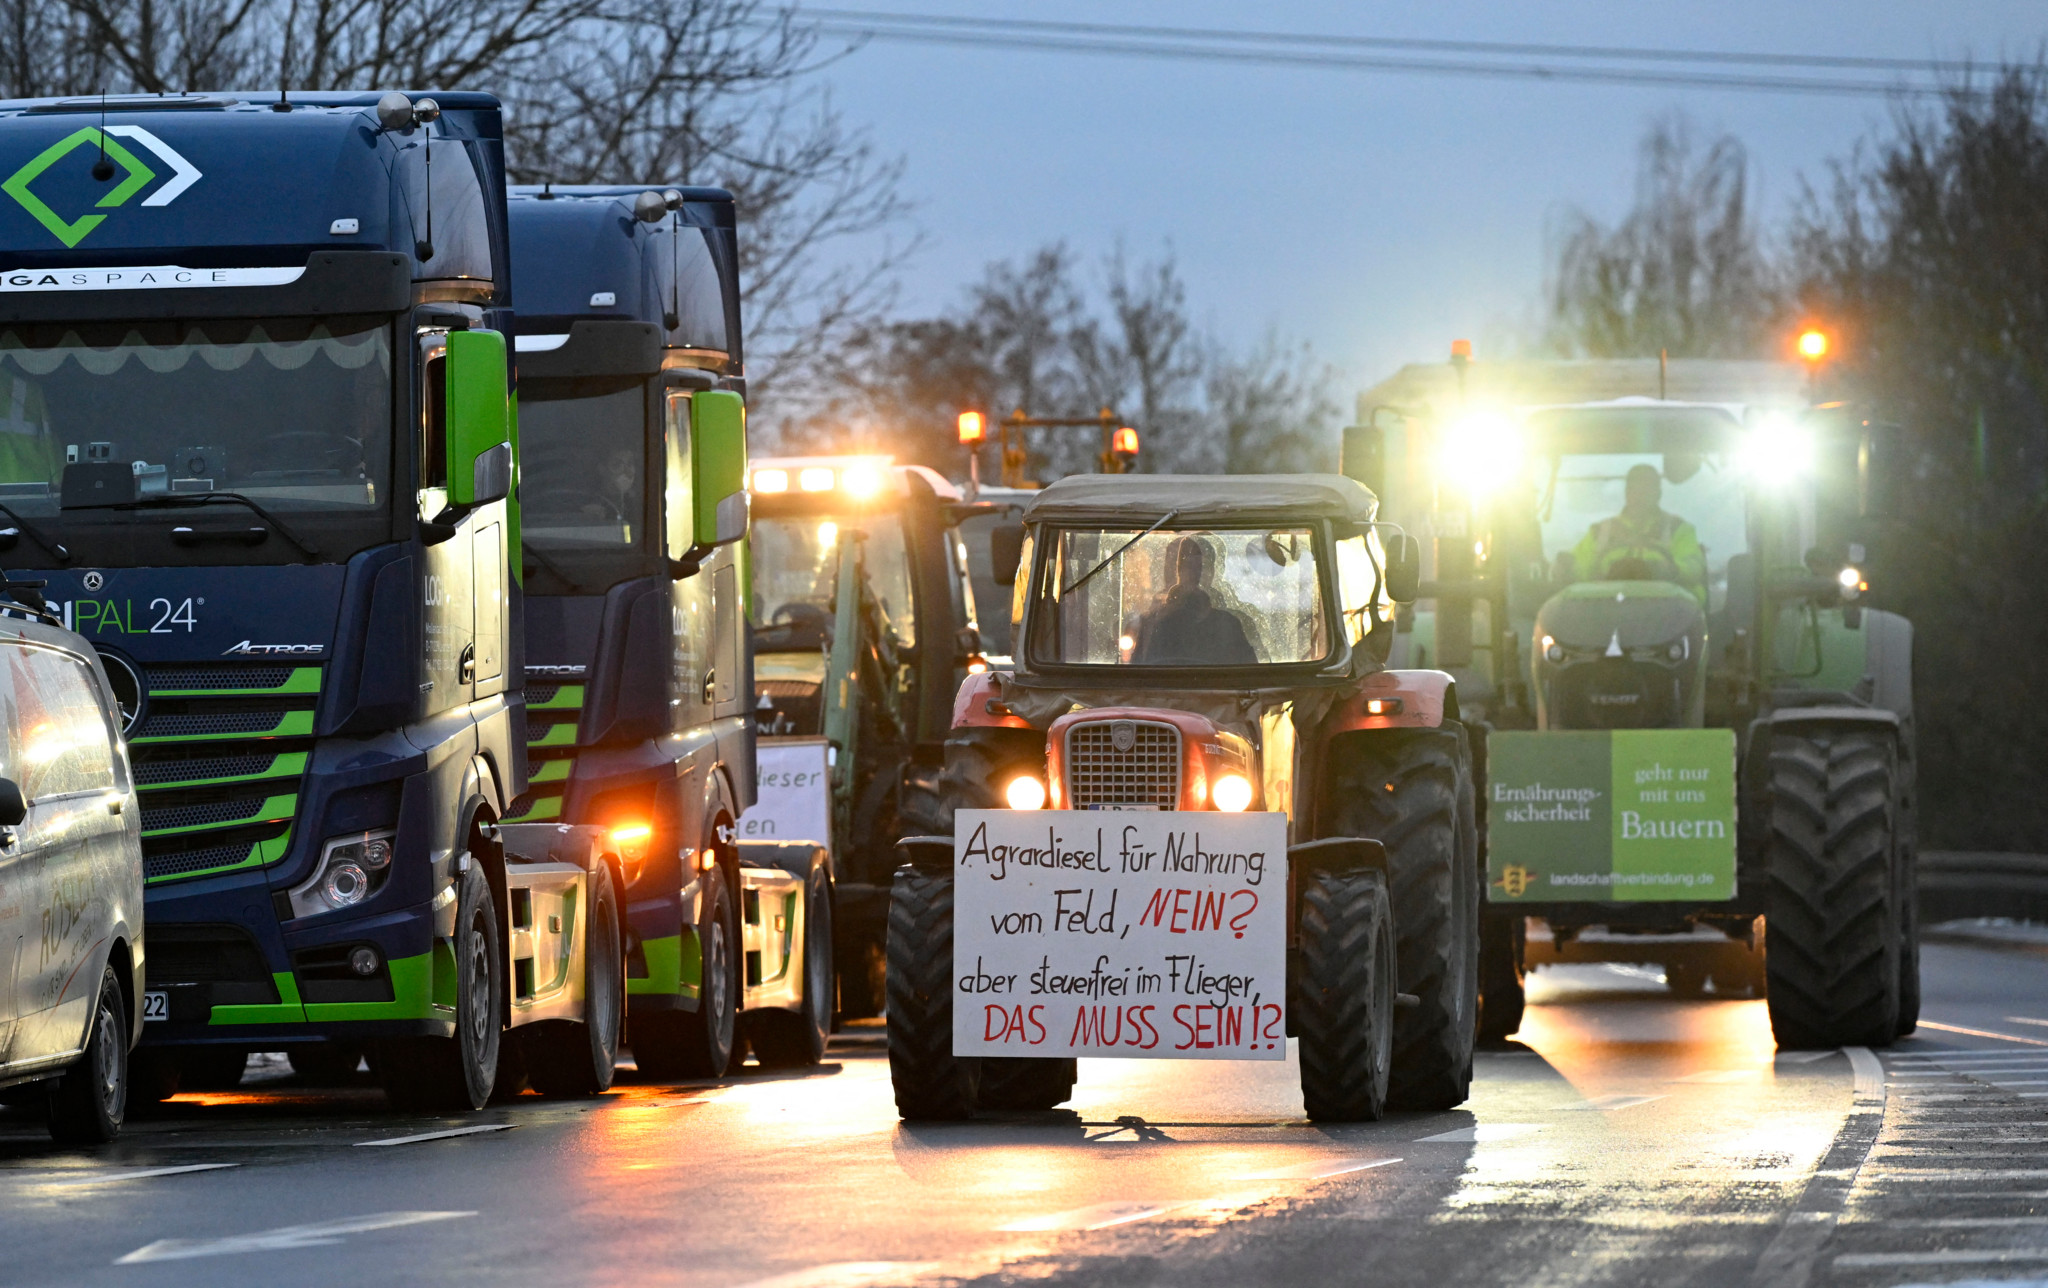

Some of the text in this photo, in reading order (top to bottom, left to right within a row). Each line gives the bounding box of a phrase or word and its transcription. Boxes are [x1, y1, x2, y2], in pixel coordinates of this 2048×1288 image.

[1635, 763, 1709, 784] geht nur
[1494, 783, 1602, 803] Ernährungs-
[1640, 789, 1706, 803] mit uns
[1505, 803, 1591, 822] sicherheit
[1621, 811, 1725, 839] Bauern
[961, 821, 1111, 881] Agrardiesel
[1119, 825, 1157, 873] für
[991, 888, 1259, 940] vom Feld, NEIN?
[958, 956, 1018, 993] aber
[1136, 966, 1161, 994] im
[1165, 954, 1261, 1010] Flieger,
[983, 1004, 1047, 1045] DAS
[1069, 1004, 1160, 1050] MUSS
